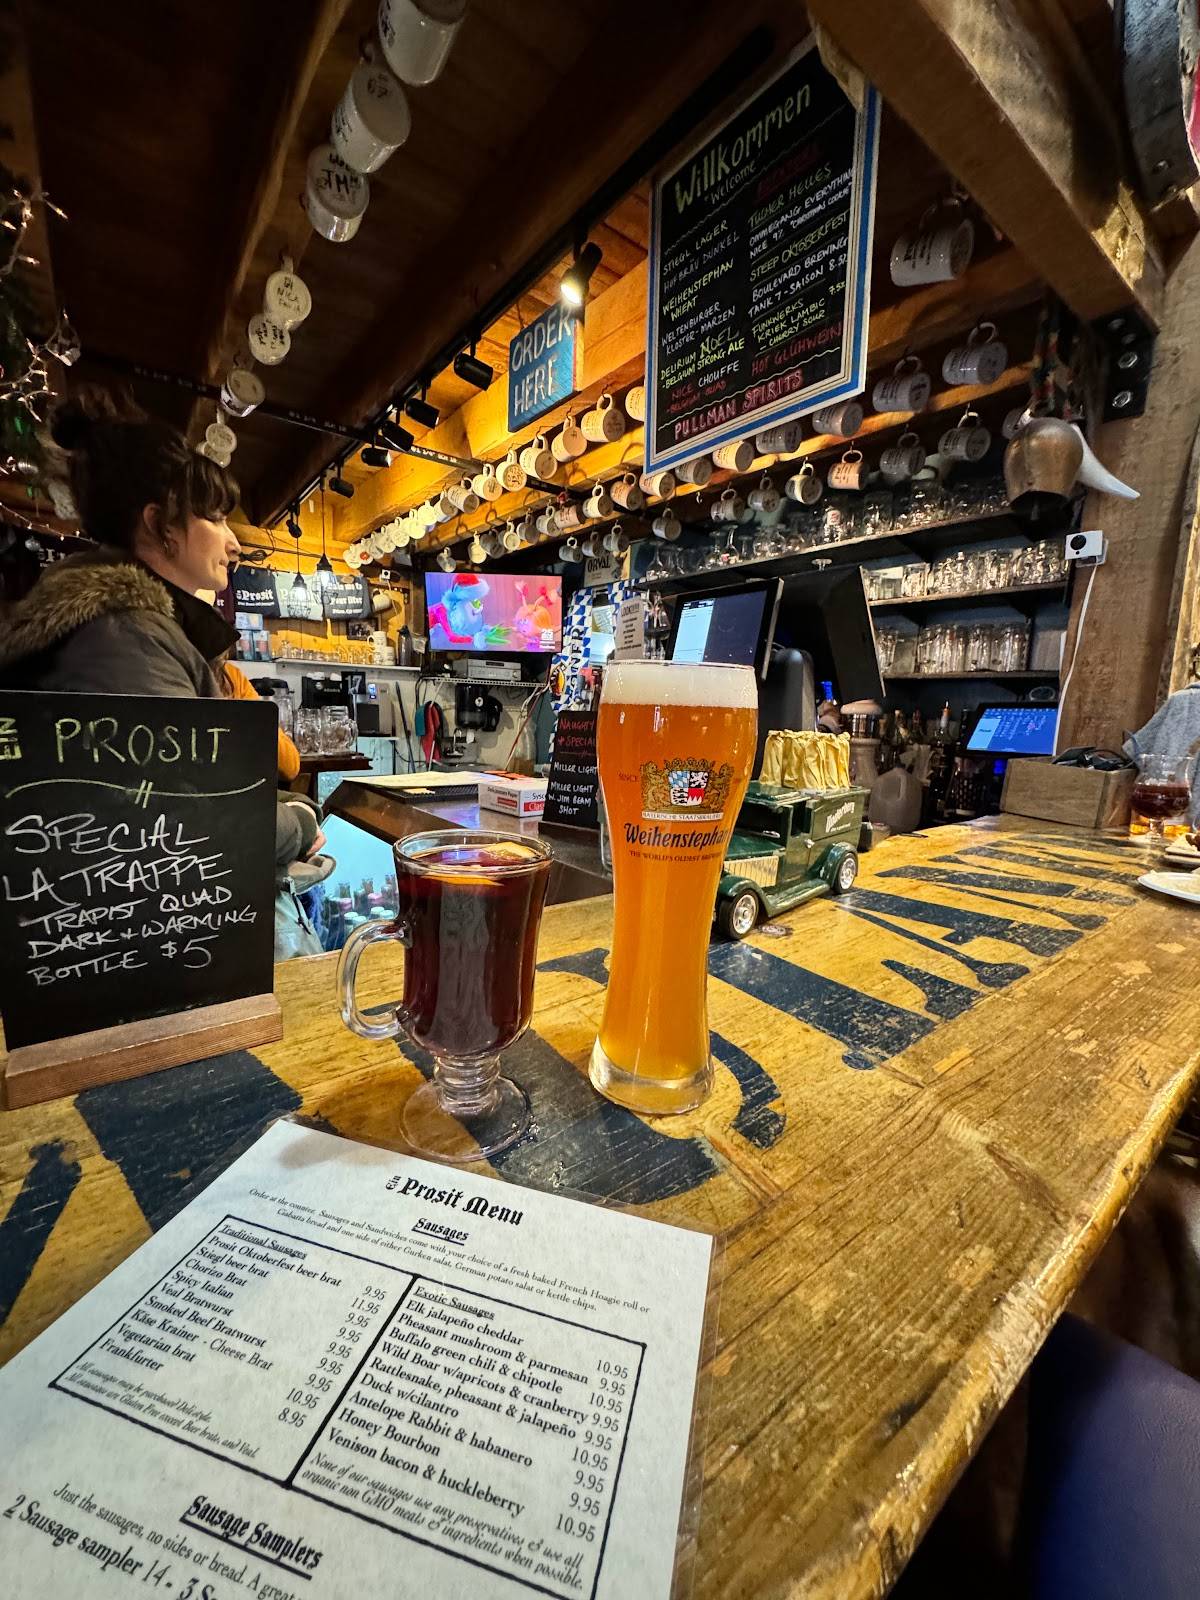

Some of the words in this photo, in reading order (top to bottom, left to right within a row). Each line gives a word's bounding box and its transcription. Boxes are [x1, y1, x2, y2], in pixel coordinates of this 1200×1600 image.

[675, 84, 810, 214] Willkommen
[663, 249, 691, 276] STIEGL
[696, 219, 728, 250] LAGER
[703, 229, 740, 264] DUNKEL
[663, 257, 734, 315] WEIHENSTEPHAN
[750, 256, 779, 281] STEEP
[752, 264, 801, 302] BOULEVARD
[804, 235, 848, 268] BREWING
[662, 301, 720, 347] WELTENBURGER
[671, 294, 698, 322] WHEAT
[747, 297, 773, 318] TANK
[757, 321, 788, 343] KRIEK
[791, 298, 825, 323] LAMBIC
[802, 309, 825, 327] SOUR
[512, 304, 571, 371] ORDER
[661, 351, 696, 381] DELIRIUM
[700, 325, 740, 360] NOEL
[697, 348, 727, 371] STRONG
[728, 337, 745, 355] ALE
[515, 352, 558, 417] HERE
[698, 360, 740, 388] CHOUFFE
[675, 398, 737, 440] PULLMAN
[742, 368, 803, 410] SPIRITS
[55, 717, 231, 766] PROSIT
[554, 761, 576, 773] MILLER
[577, 764, 597, 775] LIGHT
[572, 784, 594, 793] LIGHT
[559, 805, 580, 815] SHOT
[5, 814, 210, 855] SPECIAL
[2, 867, 80, 905] LA
[60, 852, 233, 897] TRAPPE
[159, 886, 233, 913] QUAD
[28, 930, 120, 959] DARK
[142, 905, 258, 938] WARMING
[27, 950, 149, 986] BOTTLE
[161, 934, 219, 969] $5
[397, 1177, 464, 1208] Prosit
[462, 1196, 524, 1226] Menu
[219, 1224, 270, 1250] Traditional
[266, 1237, 307, 1259] Sausages
[414, 1217, 470, 1242] Sausages
[185, 1258, 223, 1279] Chorizo
[225, 1271, 248, 1287] Brat
[197, 1246, 228, 1268] Stiegl
[226, 1254, 253, 1273] beer
[248, 1261, 271, 1280] brat
[208, 1234, 239, 1255] Prosit
[238, 1244, 296, 1271] Oktoberfest
[297, 1264, 319, 1279] beer
[319, 1269, 343, 1288] brat
[159, 1281, 184, 1299] Veal
[182, 1289, 235, 1318] Bratwurst
[171, 1270, 200, 1291] Spicy
[199, 1280, 235, 1299] Italian
[413, 1286, 448, 1304] Exotic
[448, 1295, 496, 1320] Sausages
[144, 1295, 187, 1319] Smoked
[187, 1307, 216, 1327] Beef
[213, 1318, 268, 1348] Bratwurst
[406, 1299, 426, 1315] Elk
[426, 1310, 475, 1333] jalapeño
[476, 1323, 524, 1346] cheddar
[99, 1337, 165, 1372] Frankfurter
[115, 1322, 171, 1353] Vegetarian
[171, 1343, 198, 1363] brat
[157, 1318, 200, 1343] Krainer
[209, 1337, 246, 1361] Cheese
[246, 1352, 274, 1371] Brat
[389, 1327, 431, 1351] Buffalo
[430, 1344, 466, 1363] green
[468, 1353, 497, 1371] chili
[498, 1363, 511, 1376] &
[513, 1368, 564, 1395] chipotle
[399, 1312, 453, 1338] Pheasant
[450, 1332, 512, 1359] mushroom
[514, 1350, 527, 1364] &
[527, 1357, 589, 1385] parmesan
[381, 1341, 411, 1360] Wild
[411, 1351, 441, 1371] Boar
[443, 1363, 505, 1396] w/apricots
[509, 1385, 522, 1399] &
[523, 1392, 588, 1424] cranberry
[595, 1359, 629, 1380] 10.95
[599, 1377, 626, 1397] 9.95
[360, 1373, 395, 1394] Duck
[397, 1387, 459, 1418] w/cilantro
[370, 1357, 442, 1392] Rattlesnake,
[446, 1384, 503, 1414] pheasant
[505, 1404, 518, 1418] &
[518, 1409, 577, 1440] jalapeño
[589, 1392, 623, 1414] 10.95
[338, 1407, 382, 1436] Honey
[384, 1424, 441, 1457] Bourbon
[349, 1390, 405, 1420] Antelope
[408, 1410, 452, 1438] Rabbit
[454, 1427, 467, 1443] &
[469, 1436, 534, 1468] habanero
[583, 1430, 613, 1451] 9.95
[592, 1413, 620, 1432] 9.95
[328, 1426, 378, 1459] Venison
[380, 1447, 420, 1475] bacon
[422, 1464, 437, 1481] &
[438, 1469, 527, 1518] huckleberry
[571, 1447, 608, 1471] 10.95
[574, 1470, 606, 1494] 9.95
[569, 1492, 601, 1516] 9.95
[189, 1495, 250, 1538] Sausage
[250, 1521, 324, 1570] Samplers
[554, 1513, 597, 1542] 10.95
